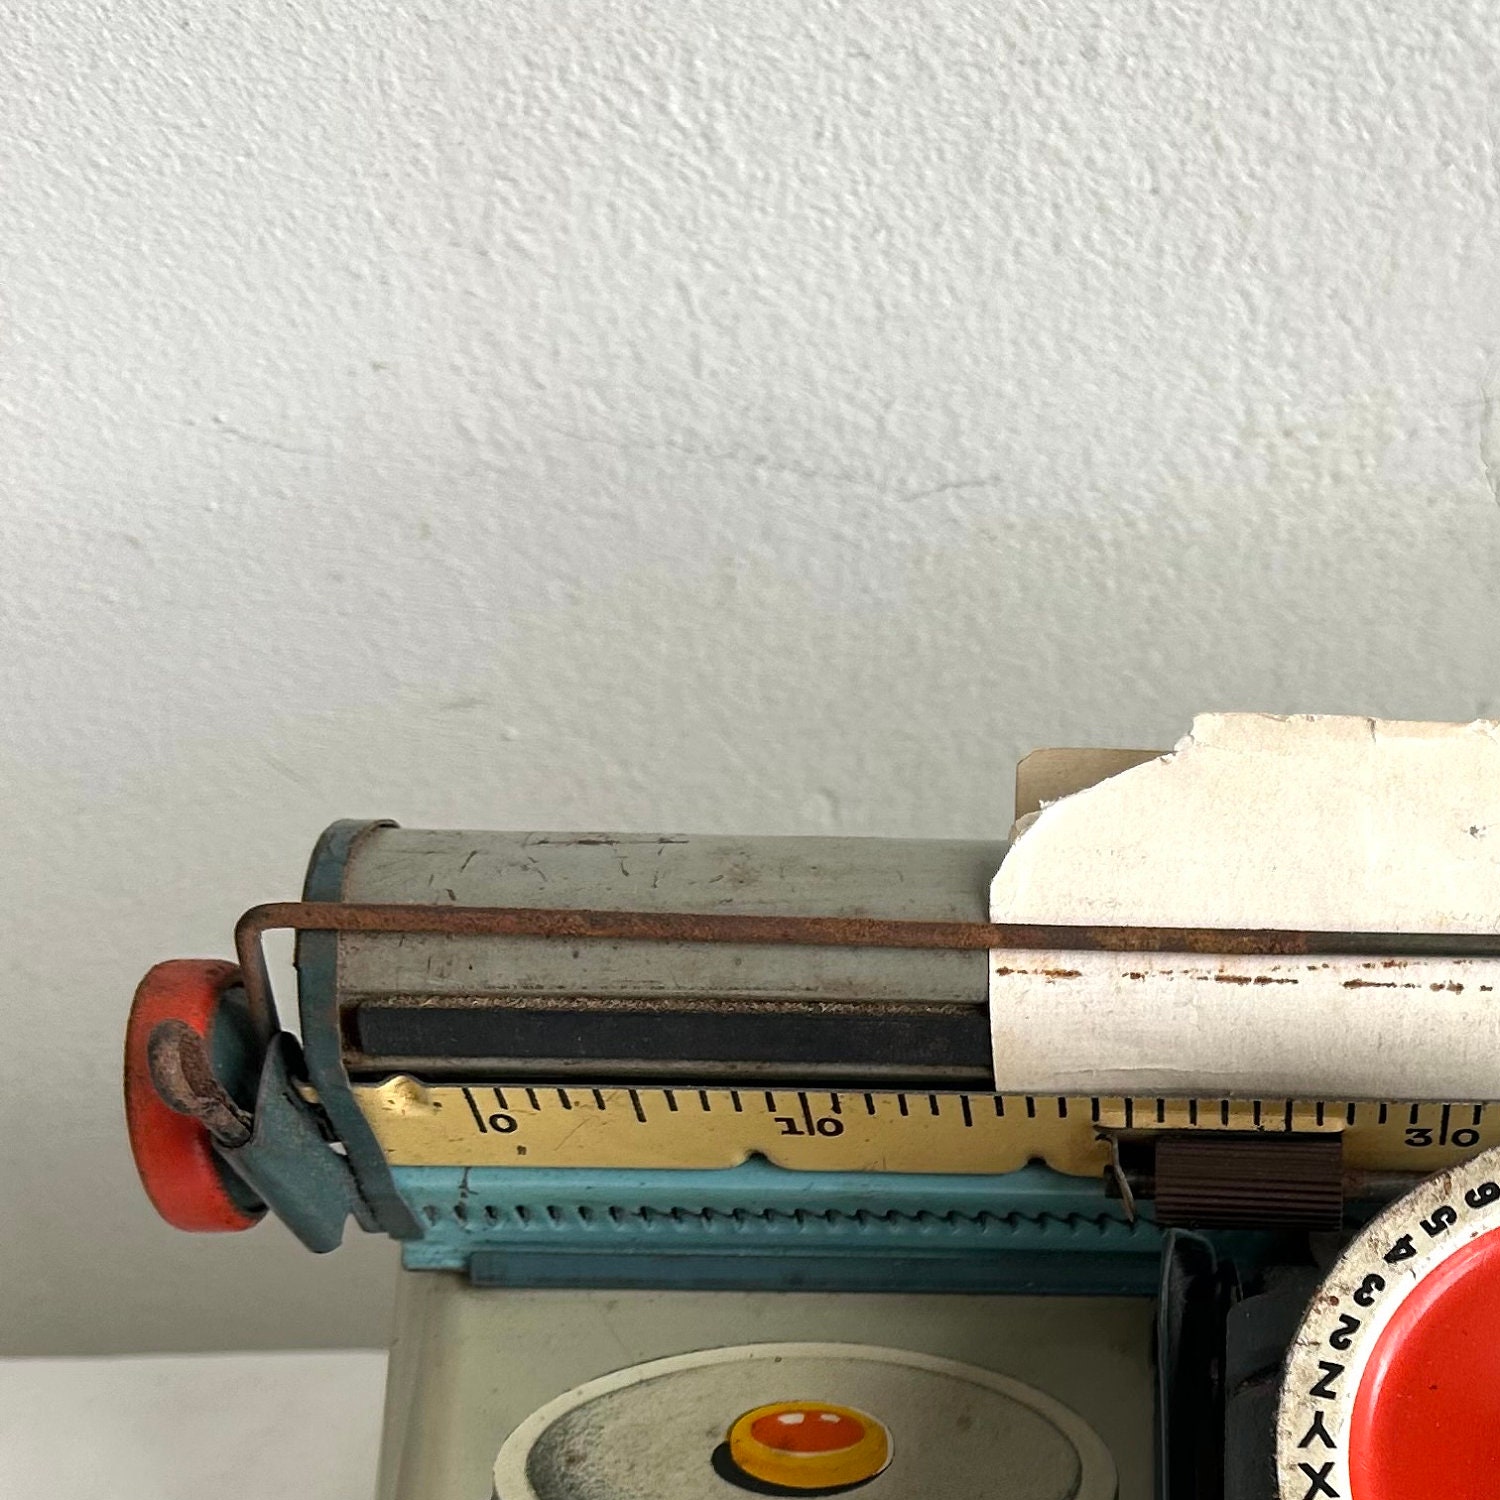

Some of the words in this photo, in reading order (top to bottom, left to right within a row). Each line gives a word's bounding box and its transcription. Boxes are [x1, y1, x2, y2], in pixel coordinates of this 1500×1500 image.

[1420, 1205, 1457, 1238] 5
[1353, 1274, 1385, 1307] 3
[1329, 1314, 1360, 1350] 2
[1309, 1361, 1345, 1400] Z
[1297, 1411, 1337, 1448] Y
